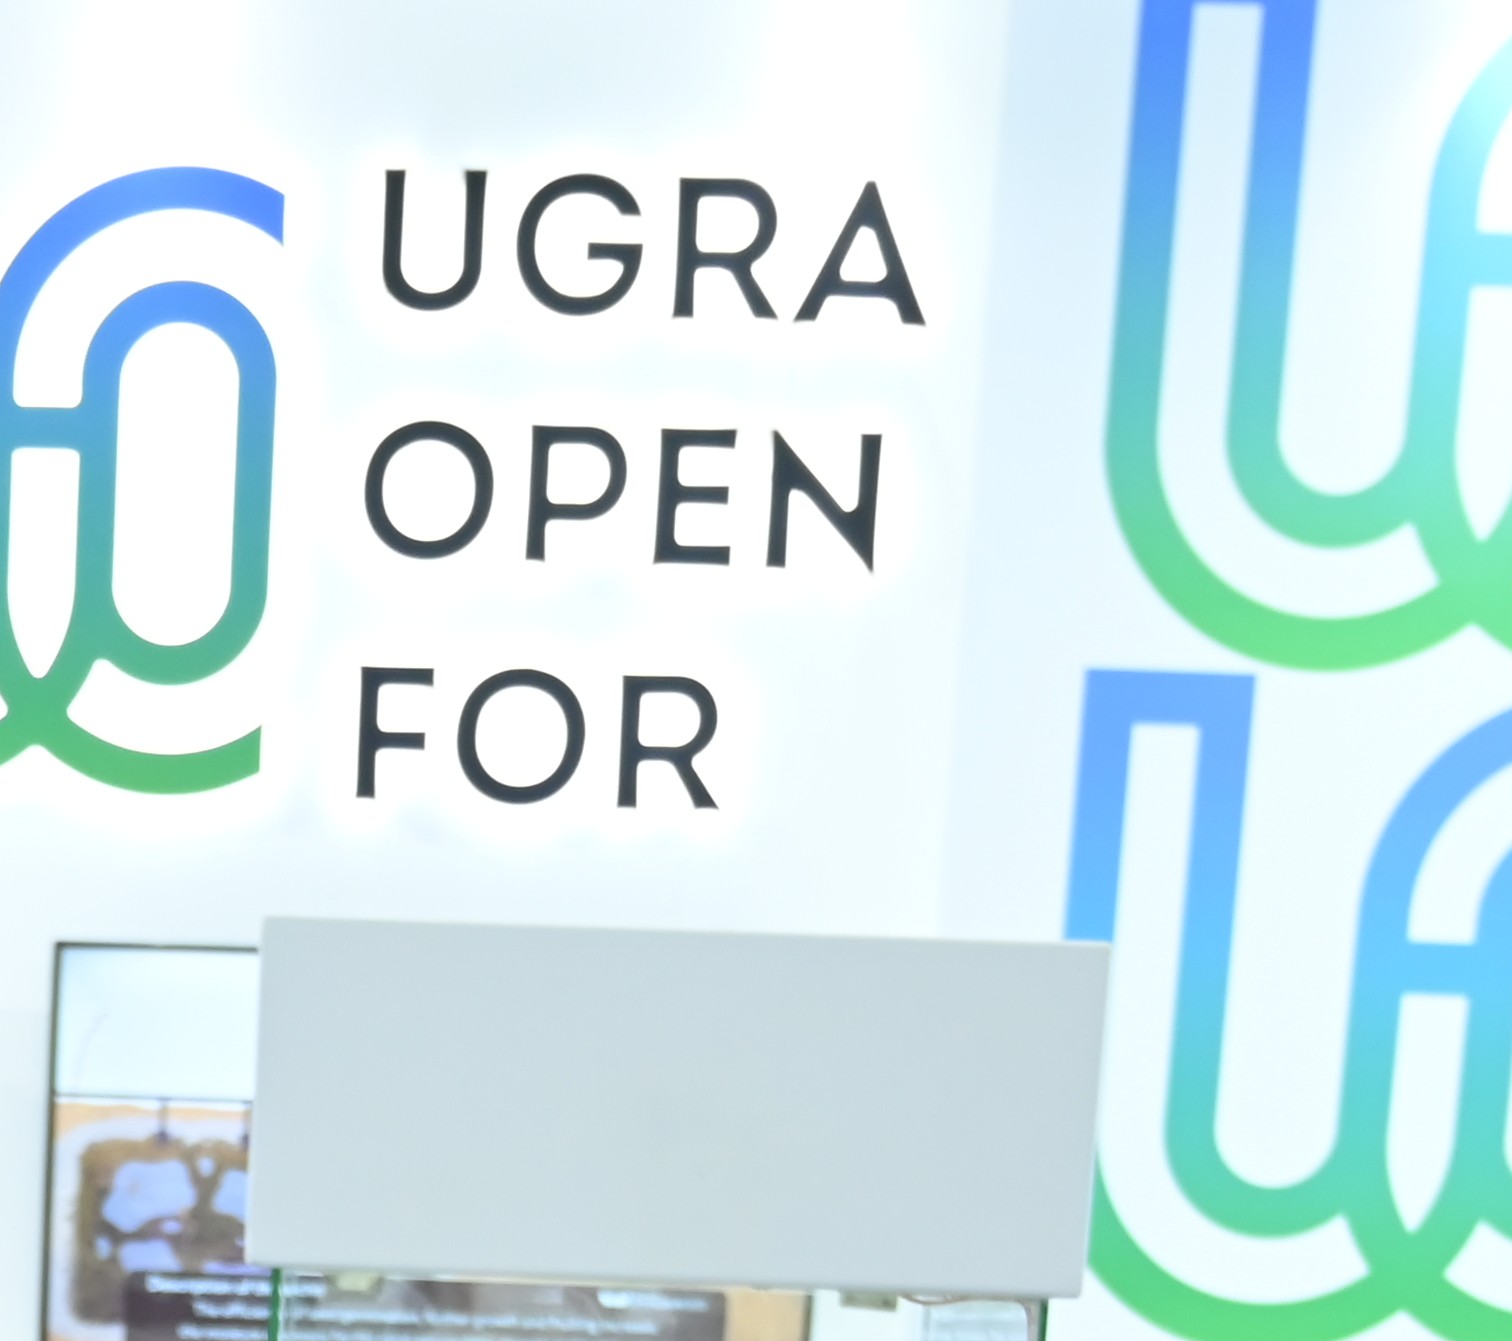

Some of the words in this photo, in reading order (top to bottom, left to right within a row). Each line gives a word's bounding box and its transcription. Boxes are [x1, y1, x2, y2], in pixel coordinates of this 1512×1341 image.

[381, 169, 926, 326] UGRA
[363, 419, 883, 573] OPEN
[356, 666, 720, 809] FOR
